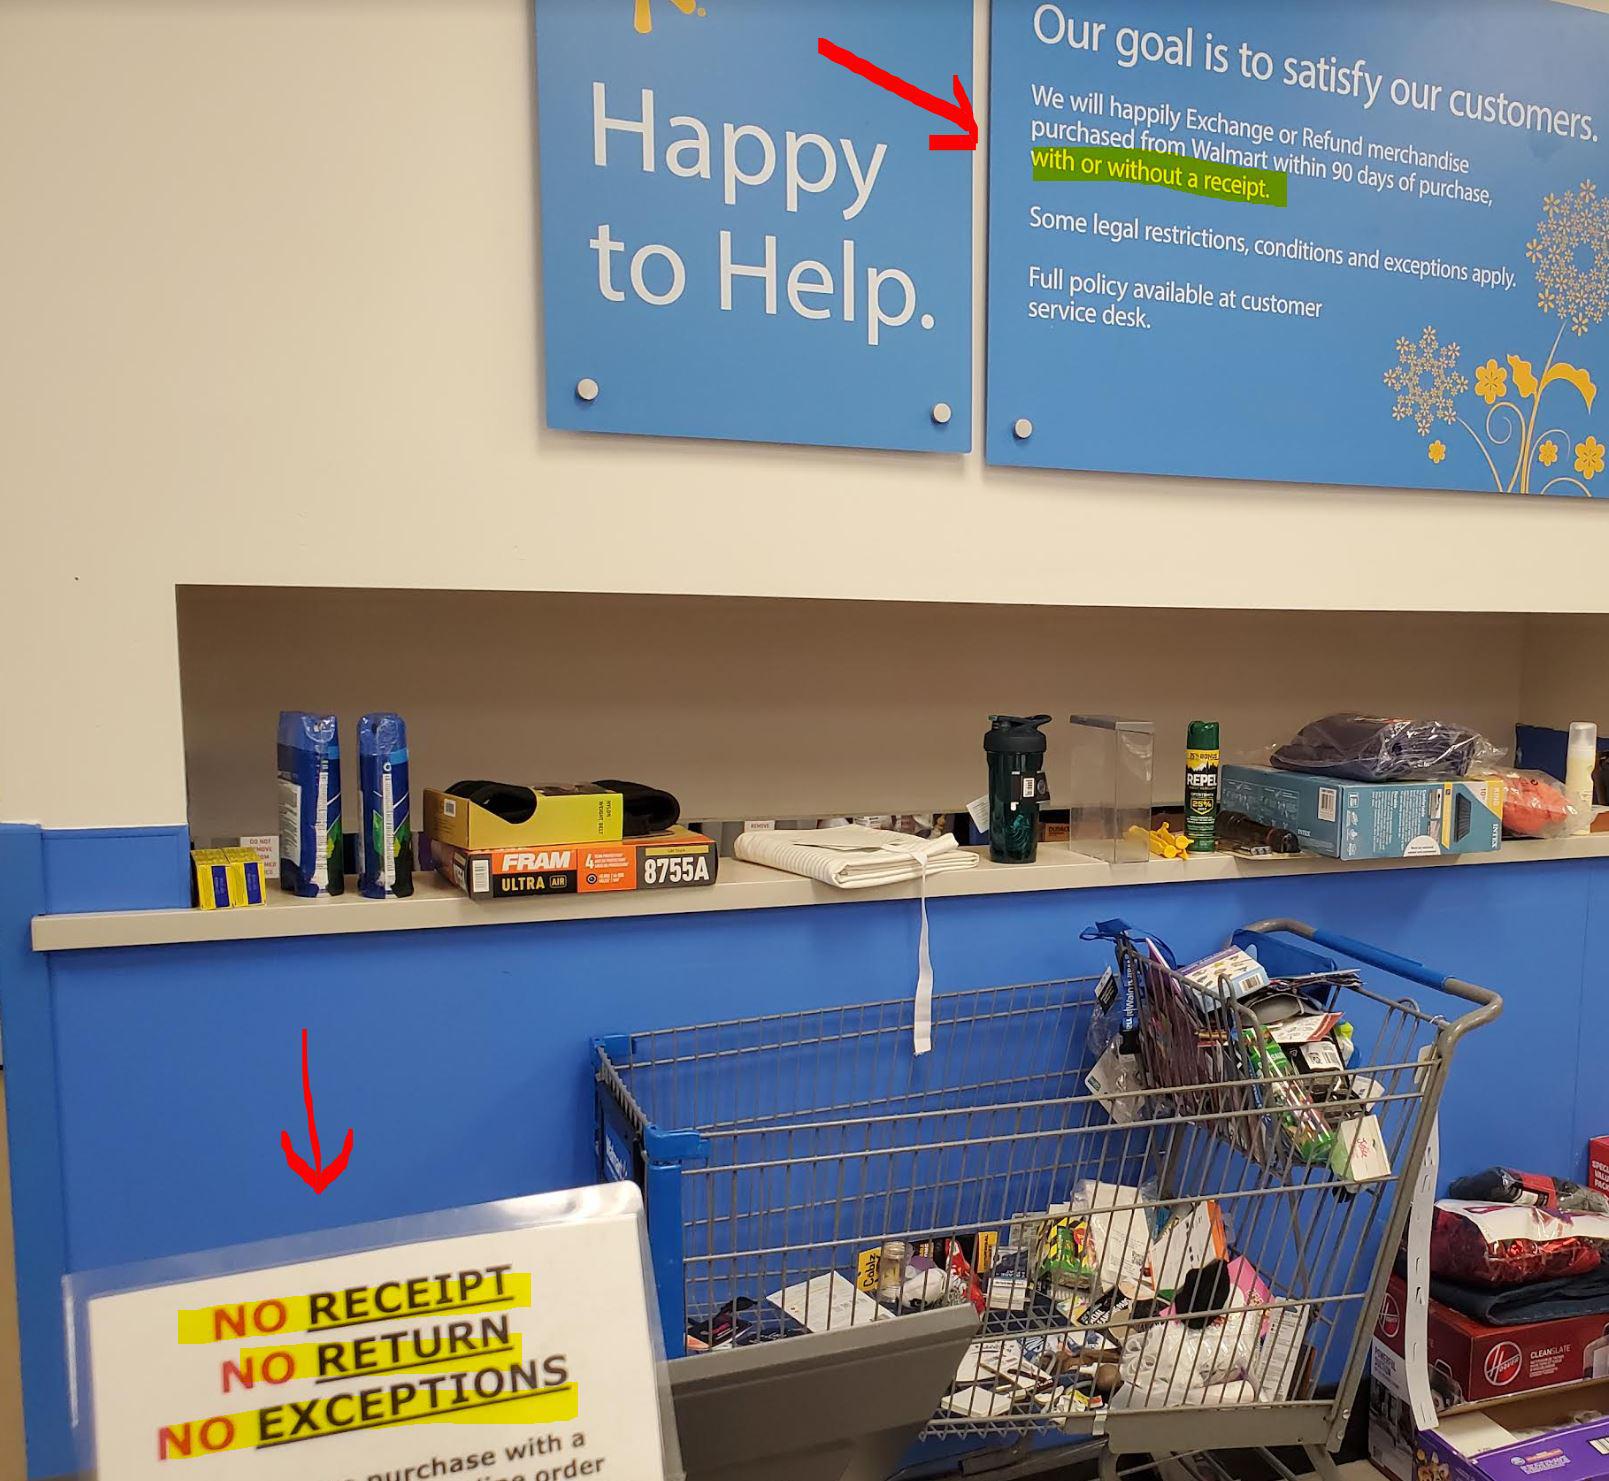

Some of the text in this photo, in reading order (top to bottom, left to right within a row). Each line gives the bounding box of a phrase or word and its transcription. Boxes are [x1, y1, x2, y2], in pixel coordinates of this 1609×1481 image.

[1033, 4, 1598, 142] Our goal is to satisfy our customers.
[1031, 84, 1469, 173] We will happily Exchange or Refund merchandise
[593, 82, 887, 220] Happy
[1031, 118, 1493, 206] purchased from Walmart within 90 days of purchase,
[1031, 149, 1270, 200] with or without a receipt.
[1030, 206, 1516, 290] Some legal restrictions, conditions and exceptions apply.
[589, 225, 935, 346] to Help.
[1029, 266, 1322, 318] Full policy available at customer
[1029, 301, 1150, 328] service desk.
[1187, 773, 1217, 787] REPEL
[1192, 800, 1212, 808] 25%
[1491, 823, 1499, 849] INTEX
[502, 850, 571, 872] FRAM
[585, 853, 595, 869] 4
[644, 856, 710, 884] 8755A
[501, 875, 566, 892] ULTRA AIR
[863, 1252, 877, 1288] Cablz
[213, 1264, 513, 1341] NO RECEIPT
[221, 1314, 512, 1394] NO RETURN
[1530, 1344, 1572, 1360] CLEANSLATE
[157, 1354, 569, 1461] NO EXCEPTIONS
[504, 1433, 562, 1462] with
[572, 1431, 586, 1448] a
[535, 1456, 606, 1481] order
